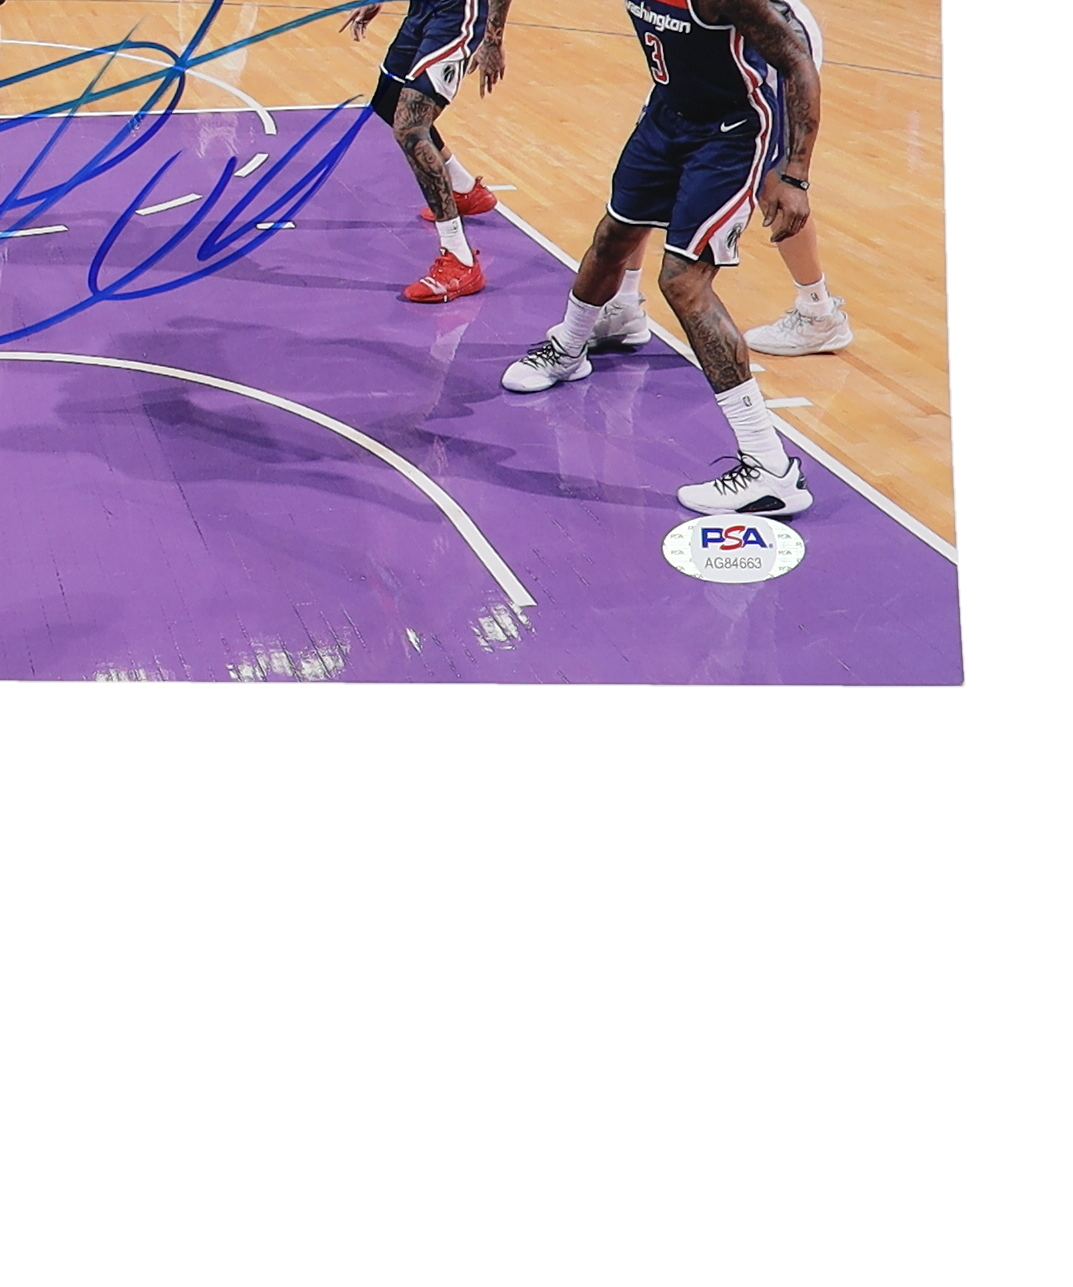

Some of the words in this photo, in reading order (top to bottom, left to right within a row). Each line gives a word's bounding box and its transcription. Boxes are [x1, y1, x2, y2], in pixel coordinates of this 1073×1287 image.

[644, 31, 670, 85] 3
[701, 525, 768, 551] PSA
[704, 557, 762, 570] AG84663
